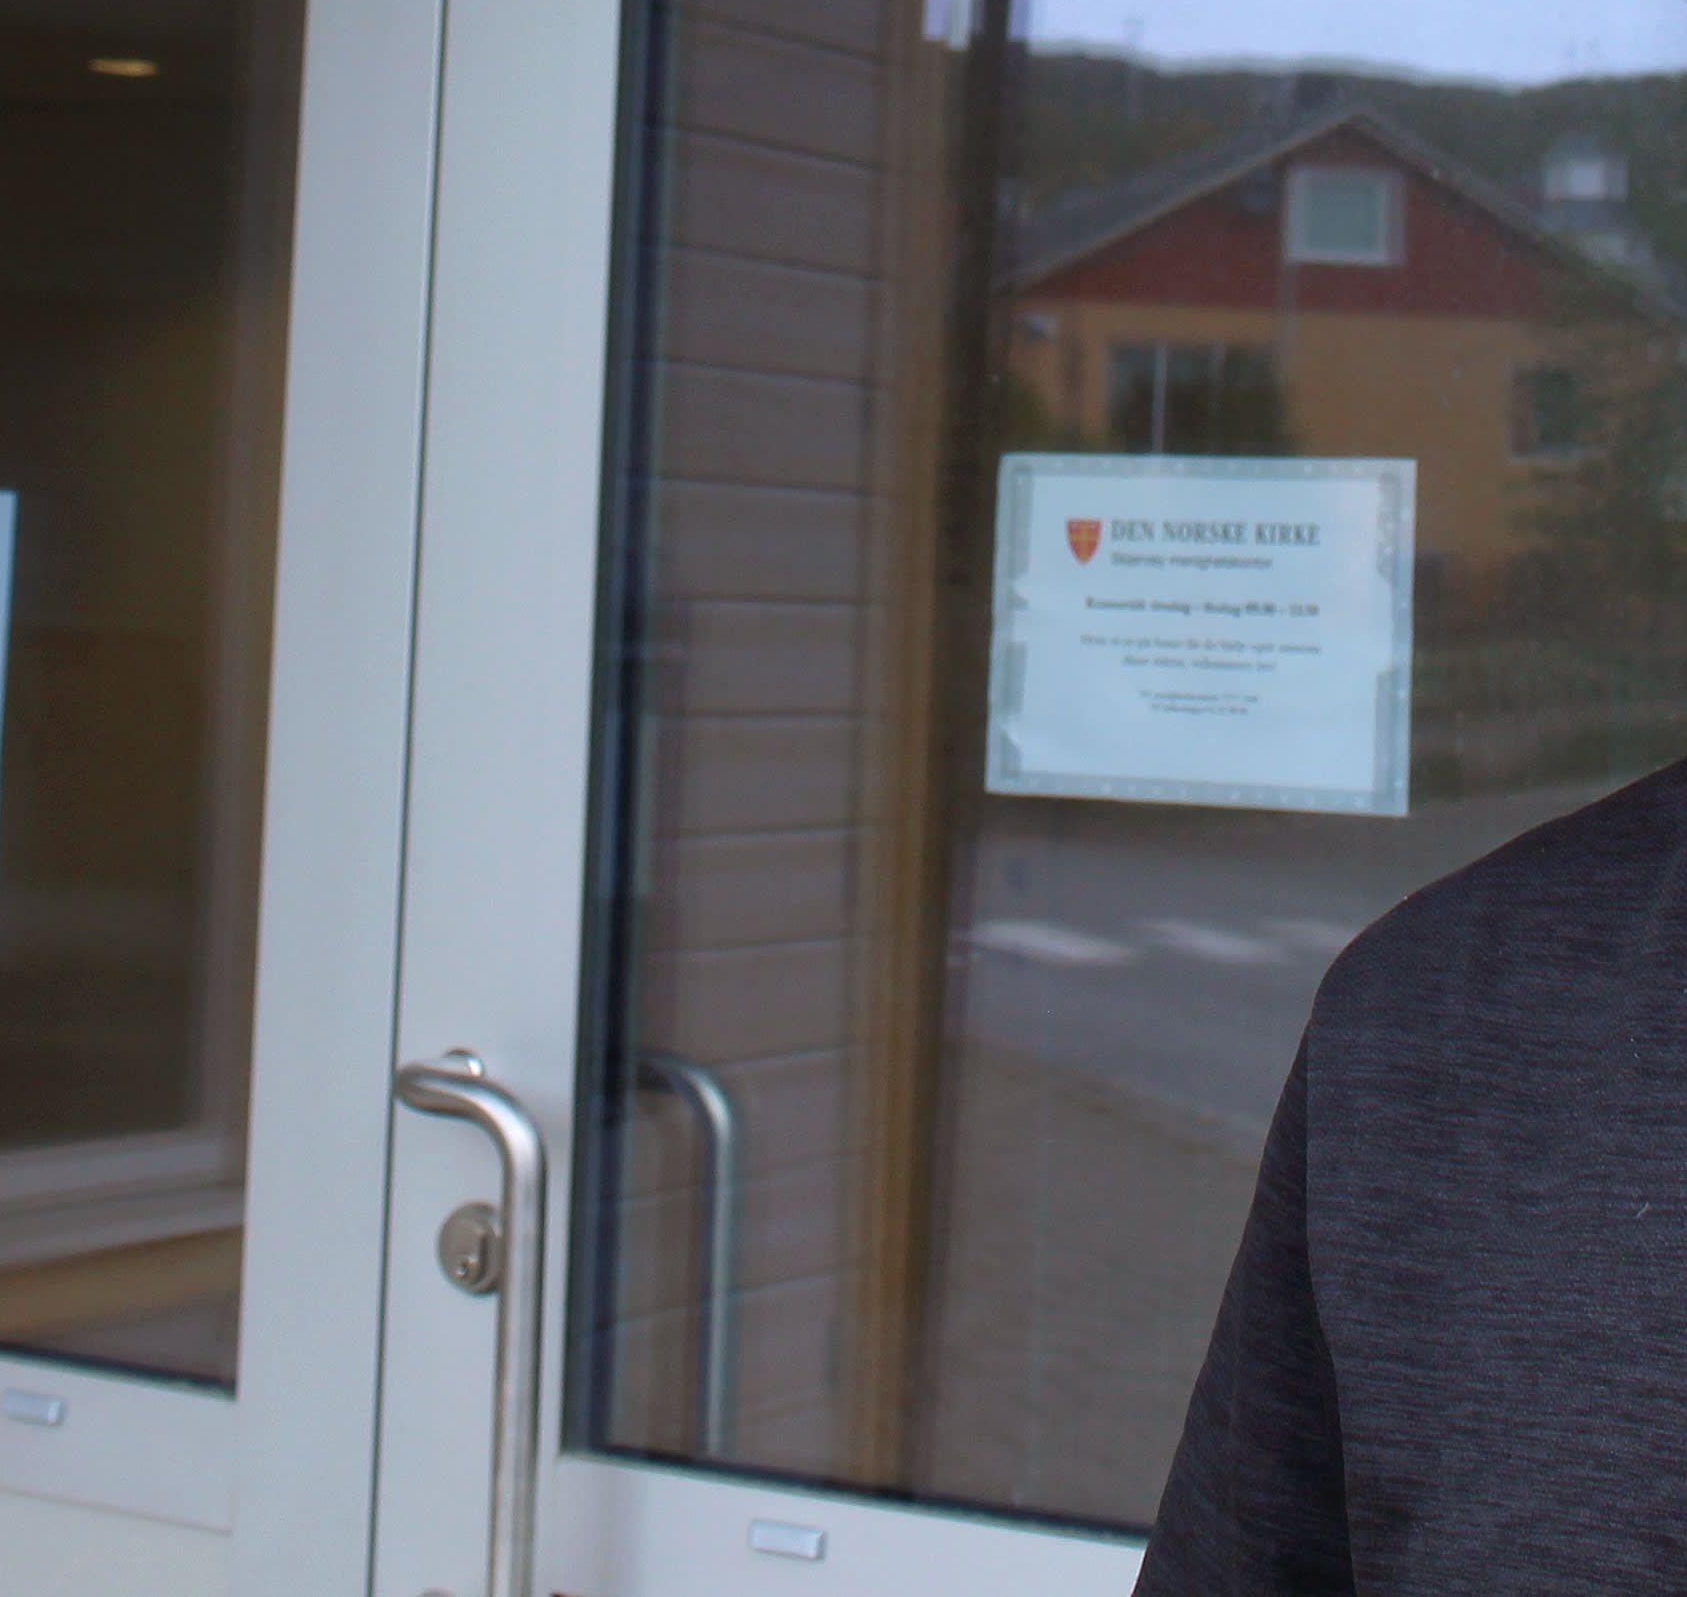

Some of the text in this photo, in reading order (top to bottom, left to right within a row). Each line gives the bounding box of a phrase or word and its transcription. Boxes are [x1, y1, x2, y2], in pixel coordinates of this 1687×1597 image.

[1111, 519, 1321, 546] DEN NORSKE KIRKE
